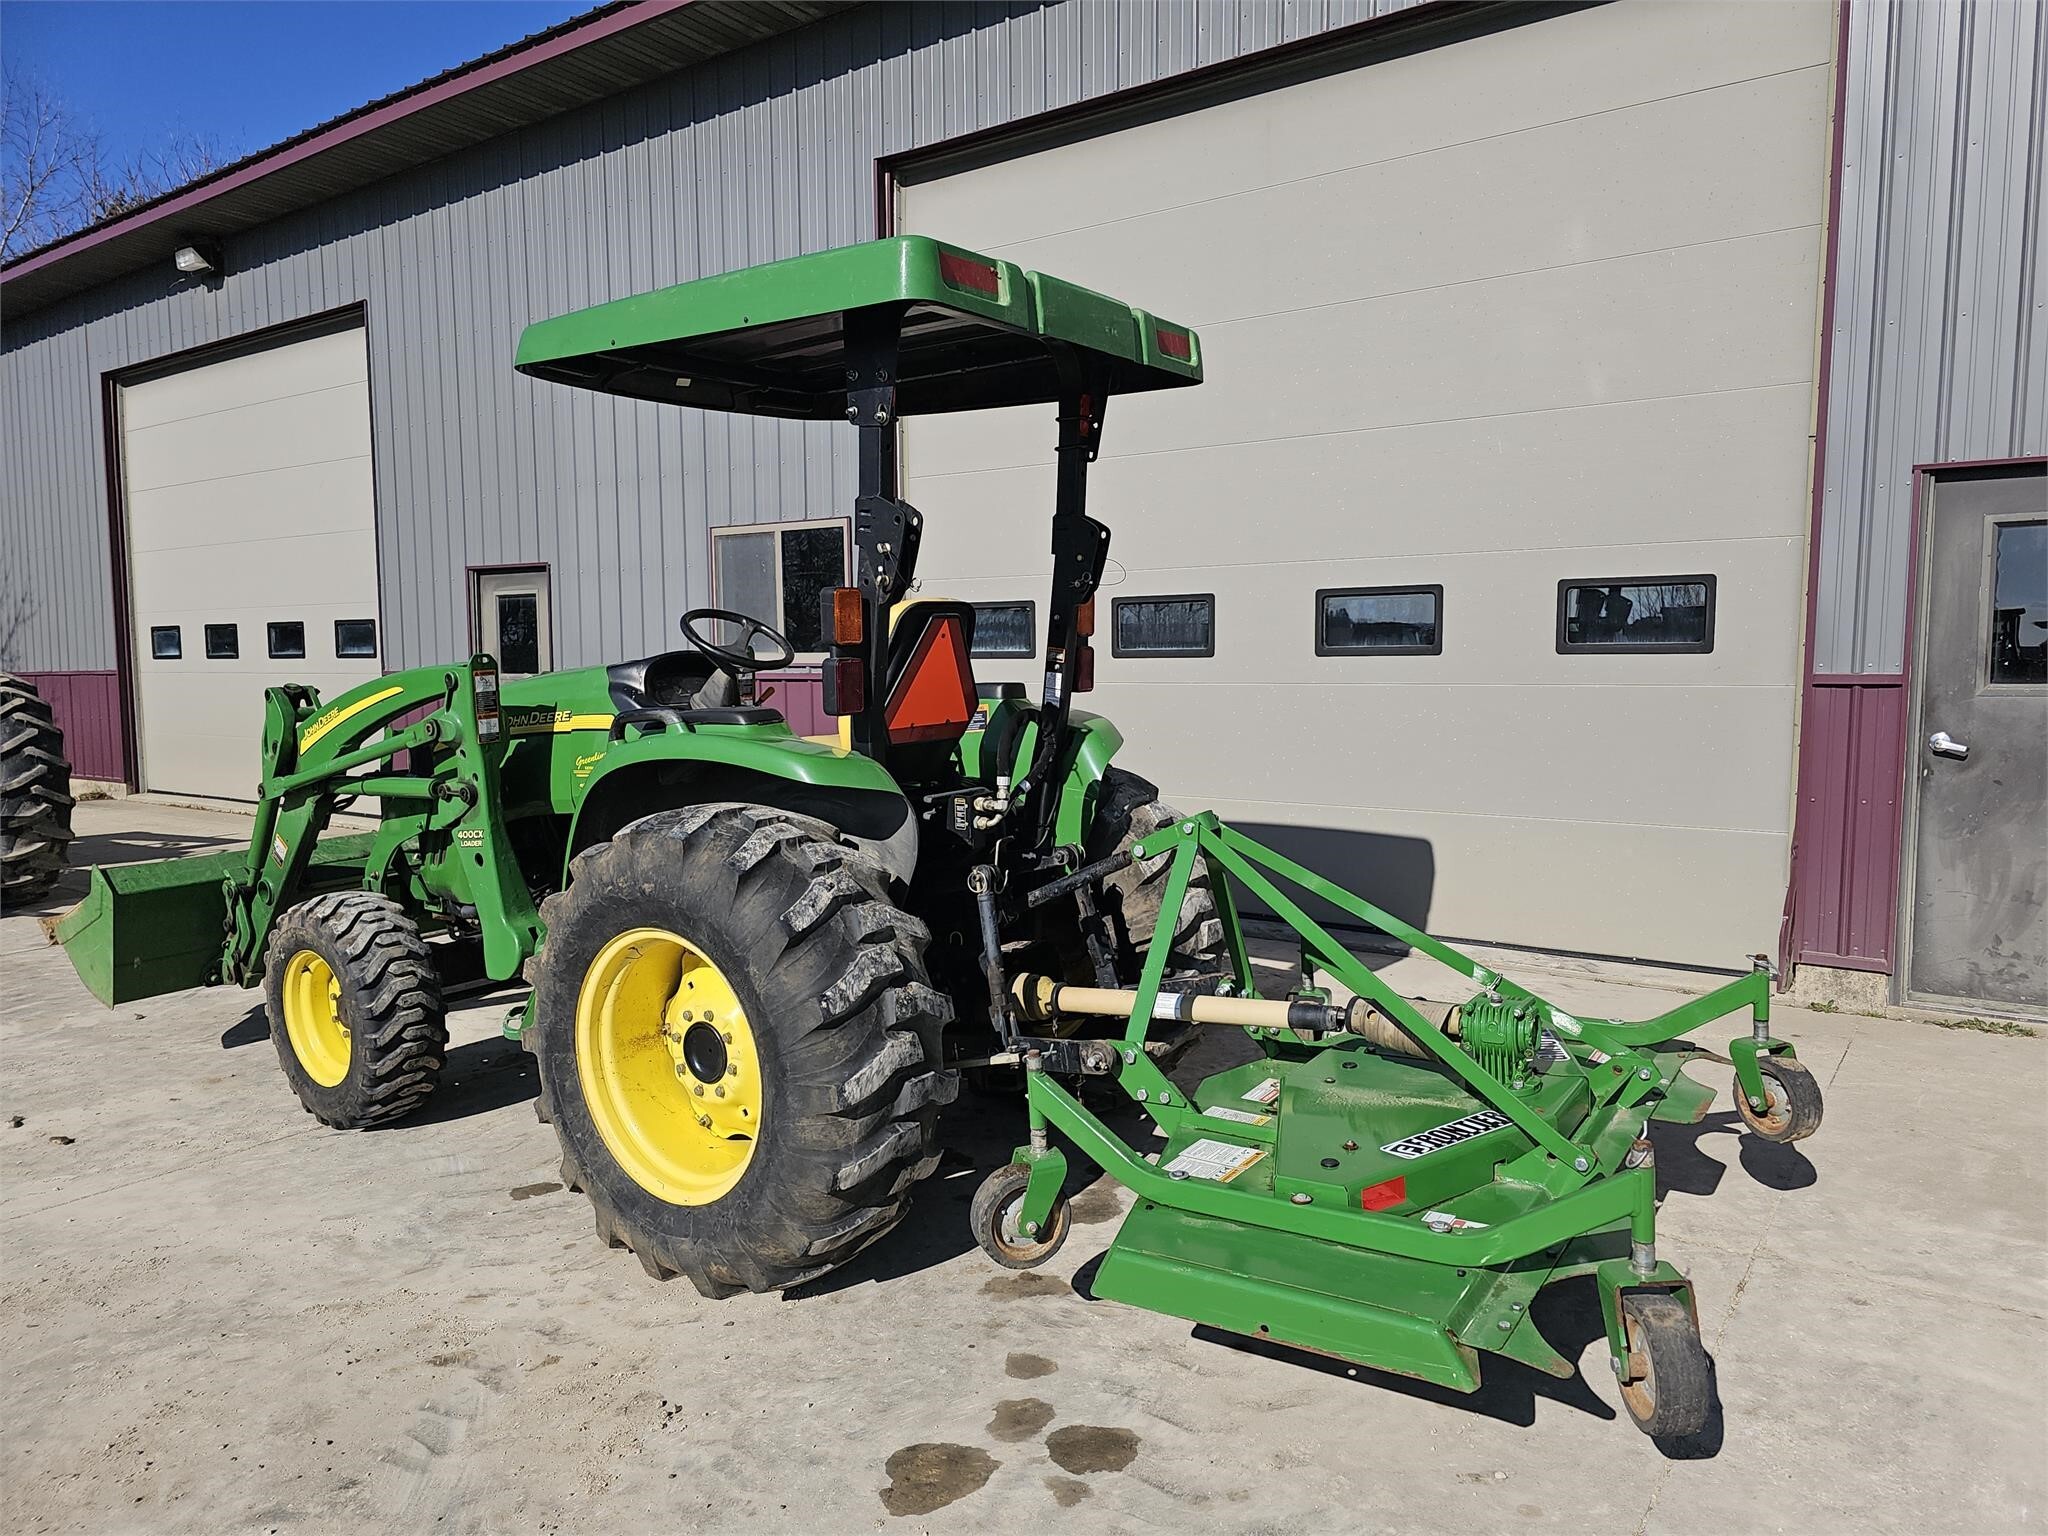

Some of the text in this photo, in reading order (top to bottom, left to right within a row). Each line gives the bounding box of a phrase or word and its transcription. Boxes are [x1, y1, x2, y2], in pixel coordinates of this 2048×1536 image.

[304, 706, 340, 740] JOHN DEERE
[529, 710, 571, 725] DEERE
[457, 830, 483, 839] 400CX
[1403, 1111, 1512, 1153] FRONTIER
